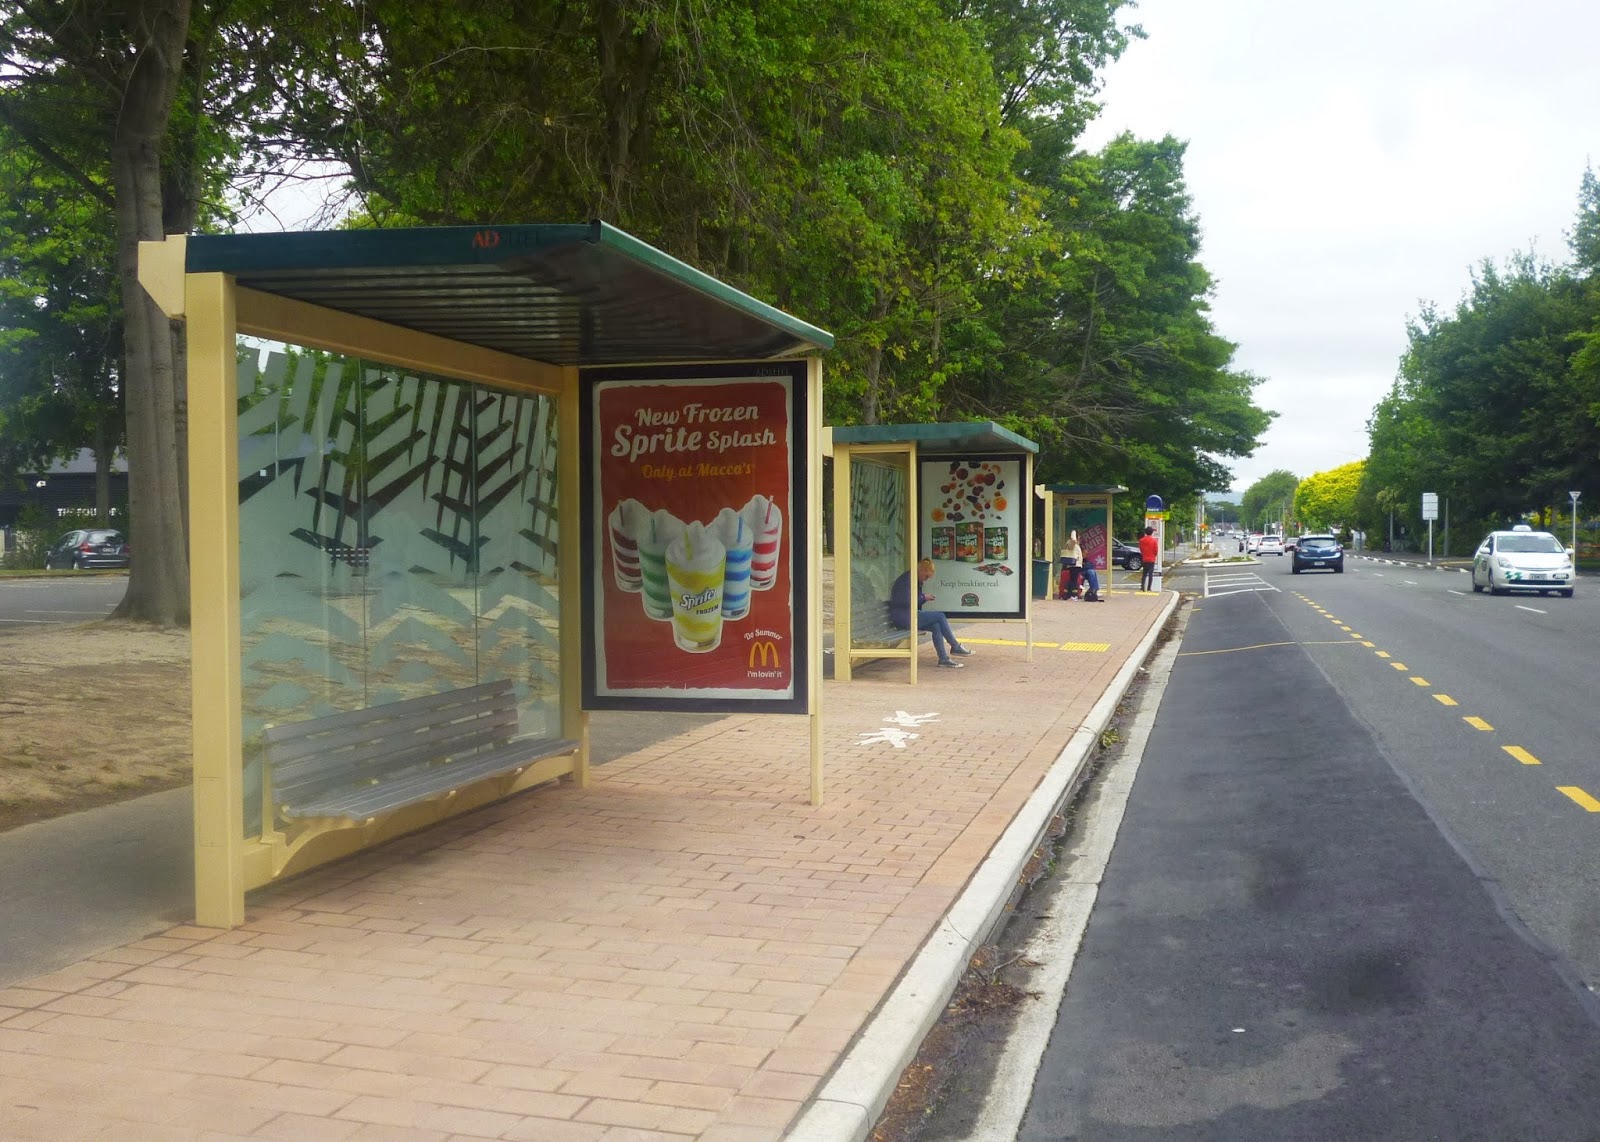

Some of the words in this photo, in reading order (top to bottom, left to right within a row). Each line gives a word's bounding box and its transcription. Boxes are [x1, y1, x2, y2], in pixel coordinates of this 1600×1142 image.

[635, 408, 680, 427] New
[683, 403, 759, 424] Frozen
[611, 424, 702, 463] Sprite
[707, 428, 776, 453] Splash
[641, 464, 674, 481] Only
[678, 465, 693, 477] at
[697, 462, 753, 477] Macca's
[940, 580, 956, 588] Keep
[958, 579, 985, 587] breakfast
[680, 588, 716, 610] Sprite
[696, 604, 719, 615] FROZEN
[755, 628, 783, 640] Summer
[747, 670, 758, 678] i'm
[777, 670, 783, 678] it
